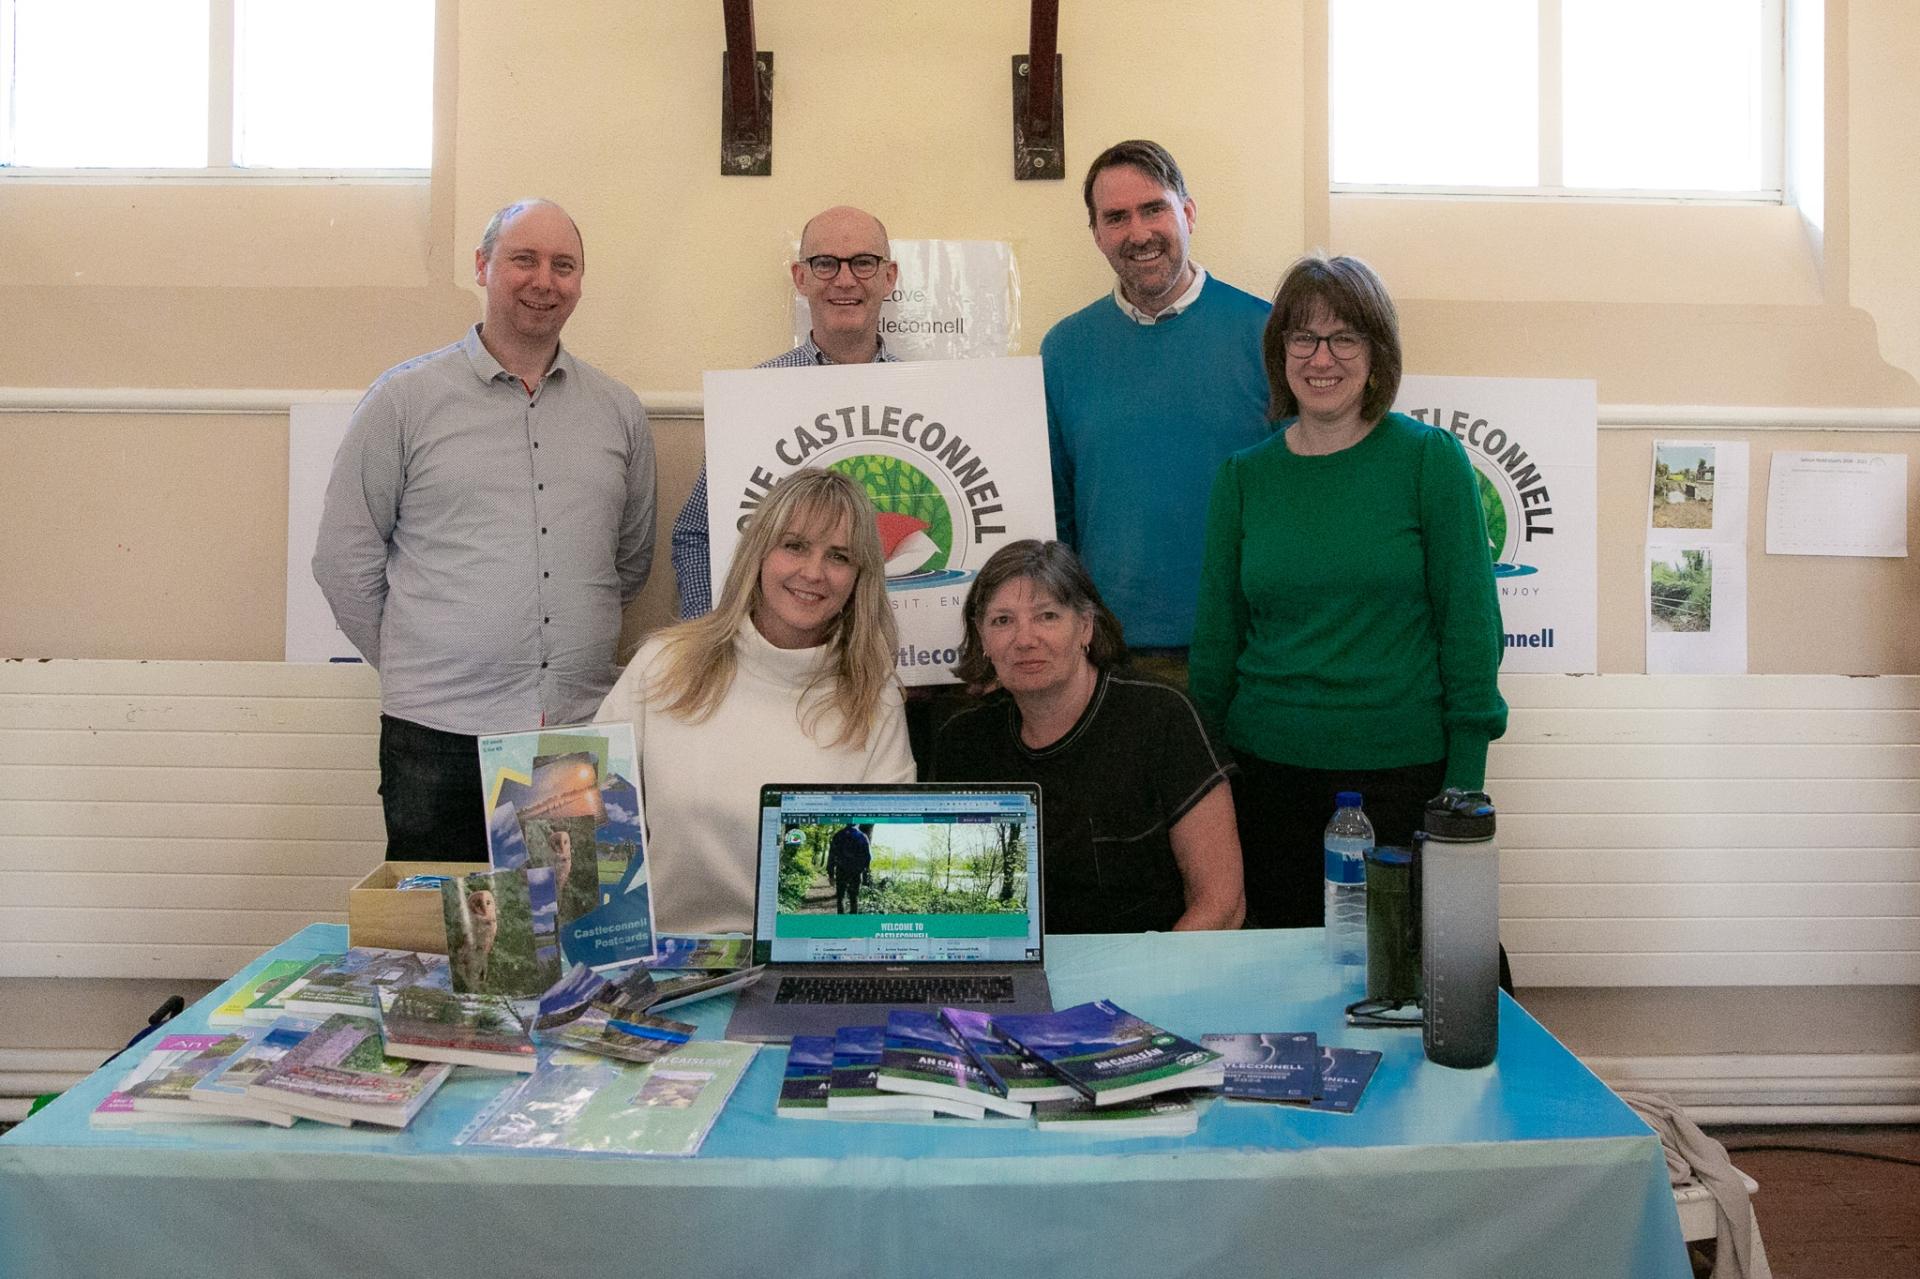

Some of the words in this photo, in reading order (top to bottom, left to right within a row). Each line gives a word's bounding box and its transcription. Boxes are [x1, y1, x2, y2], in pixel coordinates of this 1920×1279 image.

[876, 317, 964, 334] tleconnell
[775, 405, 1006, 544] CASTLECONNELL
[1410, 408, 1554, 543] TECONNELL
[1502, 587, 1540, 596] NJOY
[892, 598, 929, 610] SIT.
[574, 917, 648, 939] Castleconnell
[880, 922, 913, 931] WELCOME
[915, 922, 924, 931] TO
[594, 931, 649, 949] Postcards
[918, 1056, 936, 1066] AN
[937, 1060, 985, 1076] CAISLE
